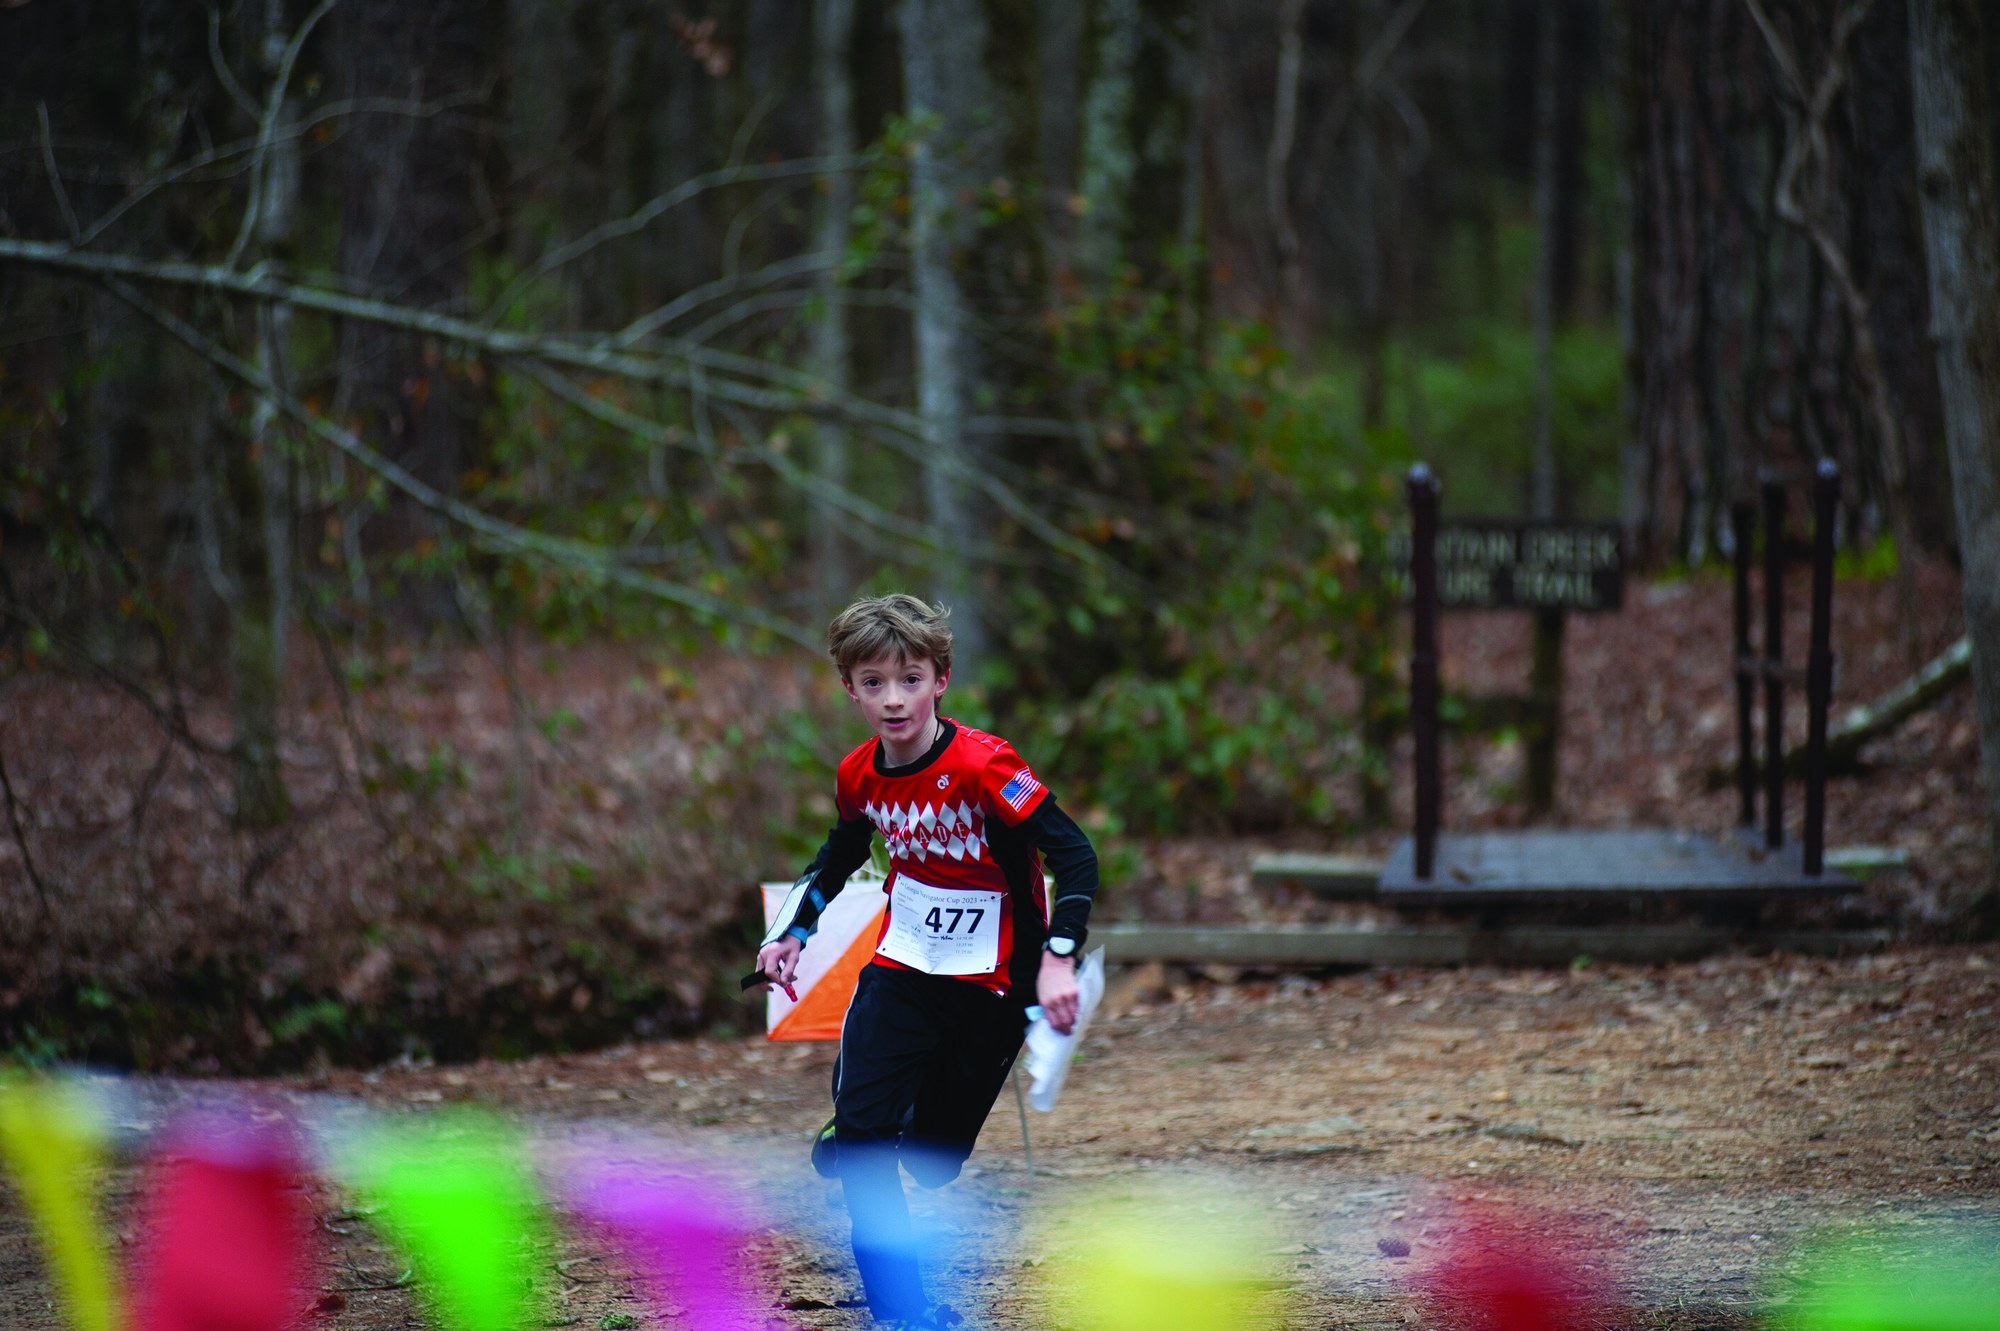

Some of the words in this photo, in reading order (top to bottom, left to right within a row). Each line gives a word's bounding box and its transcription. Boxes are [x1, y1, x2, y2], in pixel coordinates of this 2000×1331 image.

[1384, 531, 1516, 566] NTAIN
[1383, 568, 1491, 604] URE
[1513, 567, 1599, 605] TRAIL
[946, 896, 960, 904] Cup
[961, 896, 977, 904] 2023
[925, 907, 984, 933] 477
